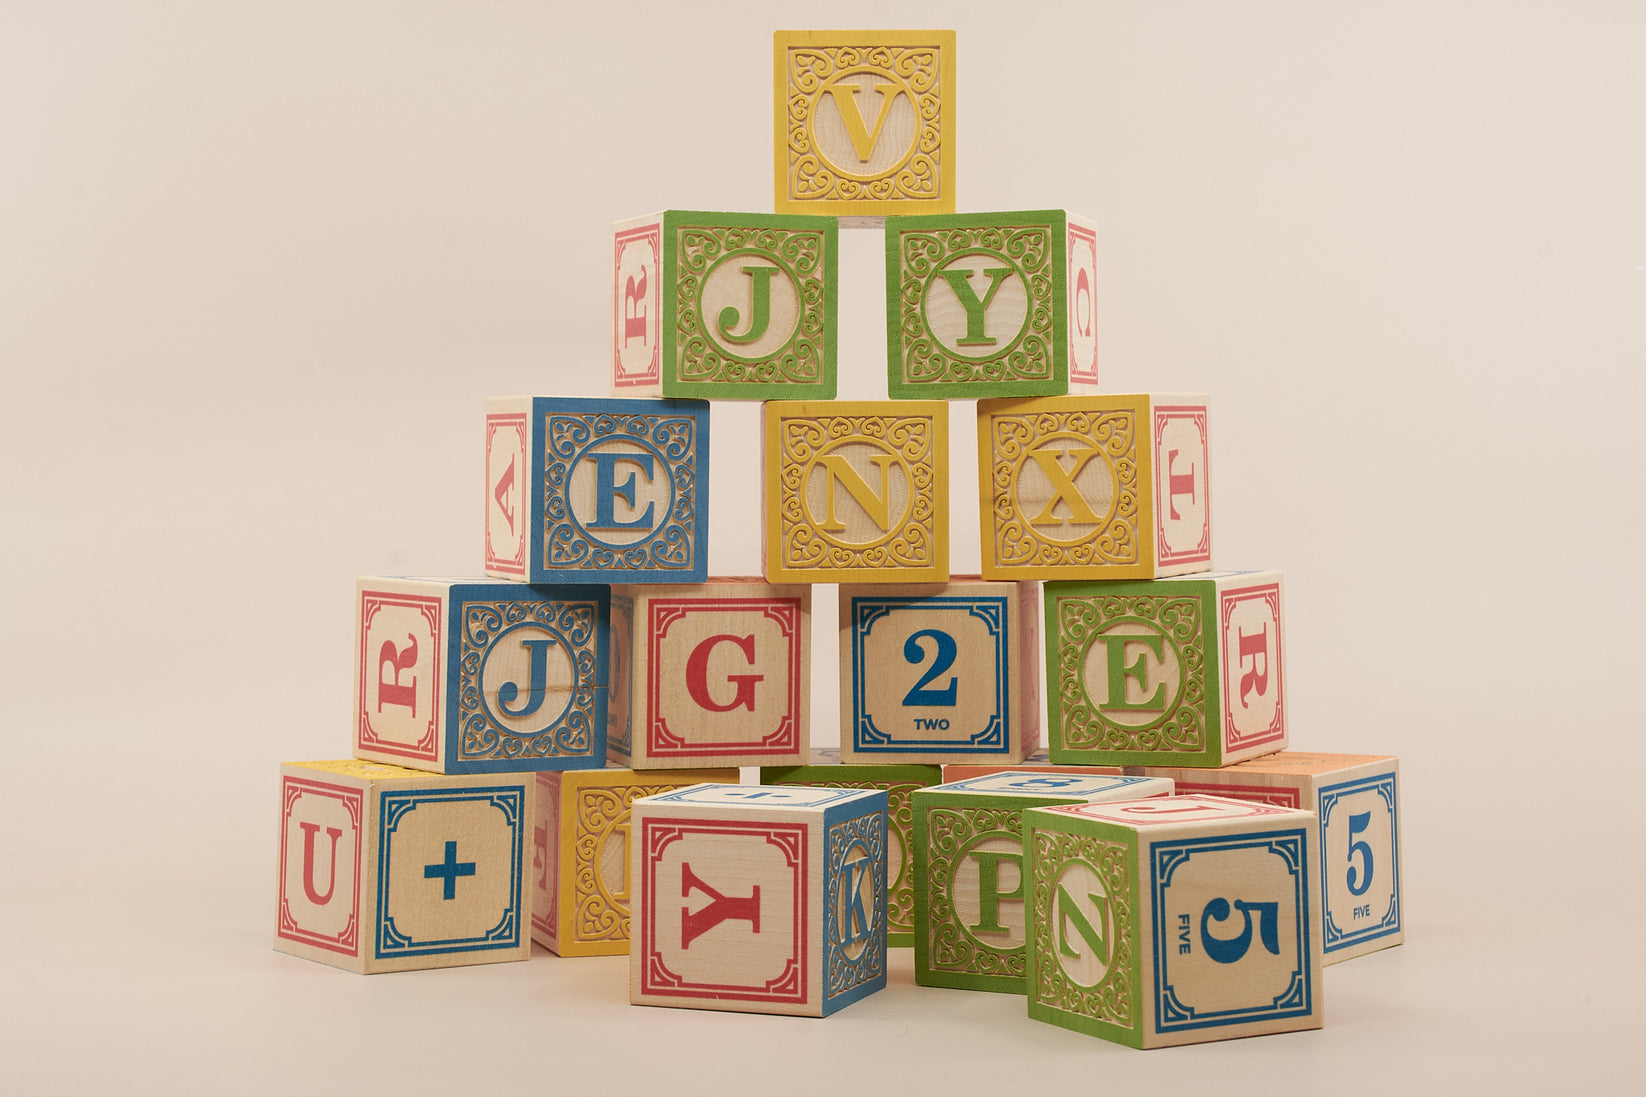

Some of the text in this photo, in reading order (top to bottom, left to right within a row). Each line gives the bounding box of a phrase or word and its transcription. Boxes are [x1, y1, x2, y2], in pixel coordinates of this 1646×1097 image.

[822, 85, 907, 163] V
[624, 264, 648, 350] R
[718, 266, 779, 343] J
[937, 267, 1013, 346] Y
[494, 451, 516, 536] A
[585, 451, 655, 530] E
[816, 454, 900, 531] N
[1027, 447, 1096, 526] X
[1168, 449, 1197, 525] T
[378, 632, 418, 718] R
[498, 639, 557, 718] J
[686, 633, 763, 712] G
[902, 629, 958, 707] 2
[1097, 633, 1166, 711] E
[1239, 621, 1268, 710] R
[913, 718, 950, 731] TWO
[299, 821, 343, 906] U
[969, 850, 1024, 935] P
[1345, 811, 1375, 896] 5
[681, 861, 761, 950] Y
[841, 855, 871, 947] K
[1177, 913, 1192, 955] FIVE
[1200, 897, 1281, 964] 5
[1352, 903, 1371, 920] FIVE
